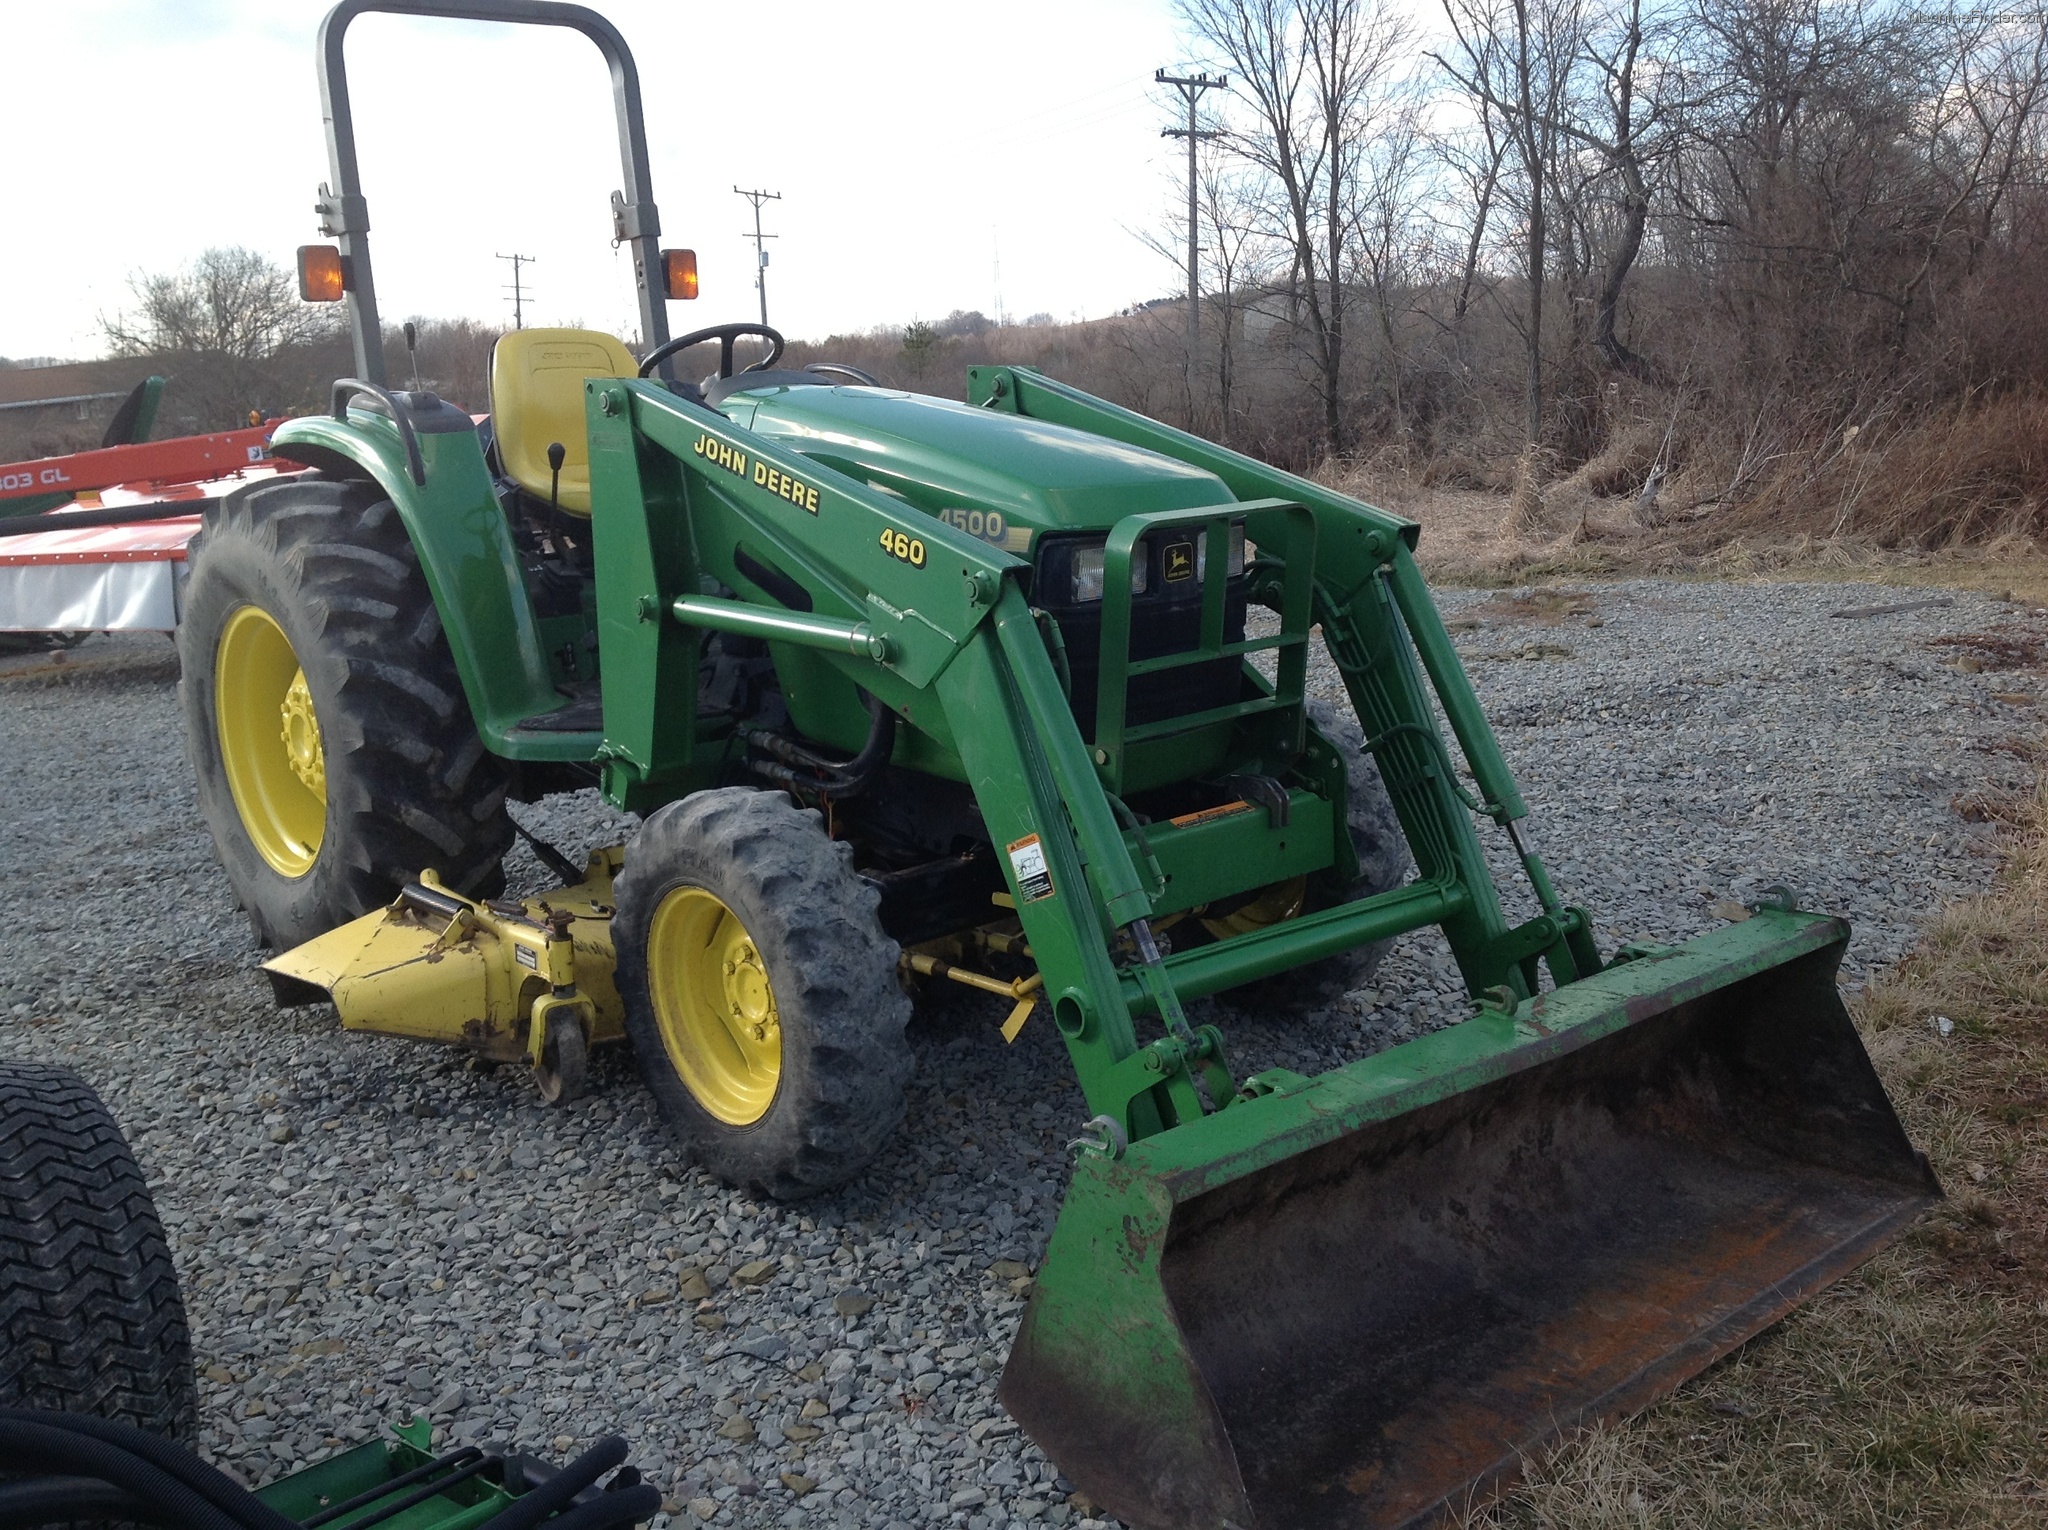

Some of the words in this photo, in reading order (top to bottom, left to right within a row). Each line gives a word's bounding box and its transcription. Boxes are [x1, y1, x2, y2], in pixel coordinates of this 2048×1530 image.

[0, 472, 33, 491] 03
[40, 468, 70, 484] GL
[693, 433, 747, 477] JOHN
[754, 460, 819, 515] DEERE
[938, 508, 1003, 539] 4500
[879, 527, 926, 568] 460
